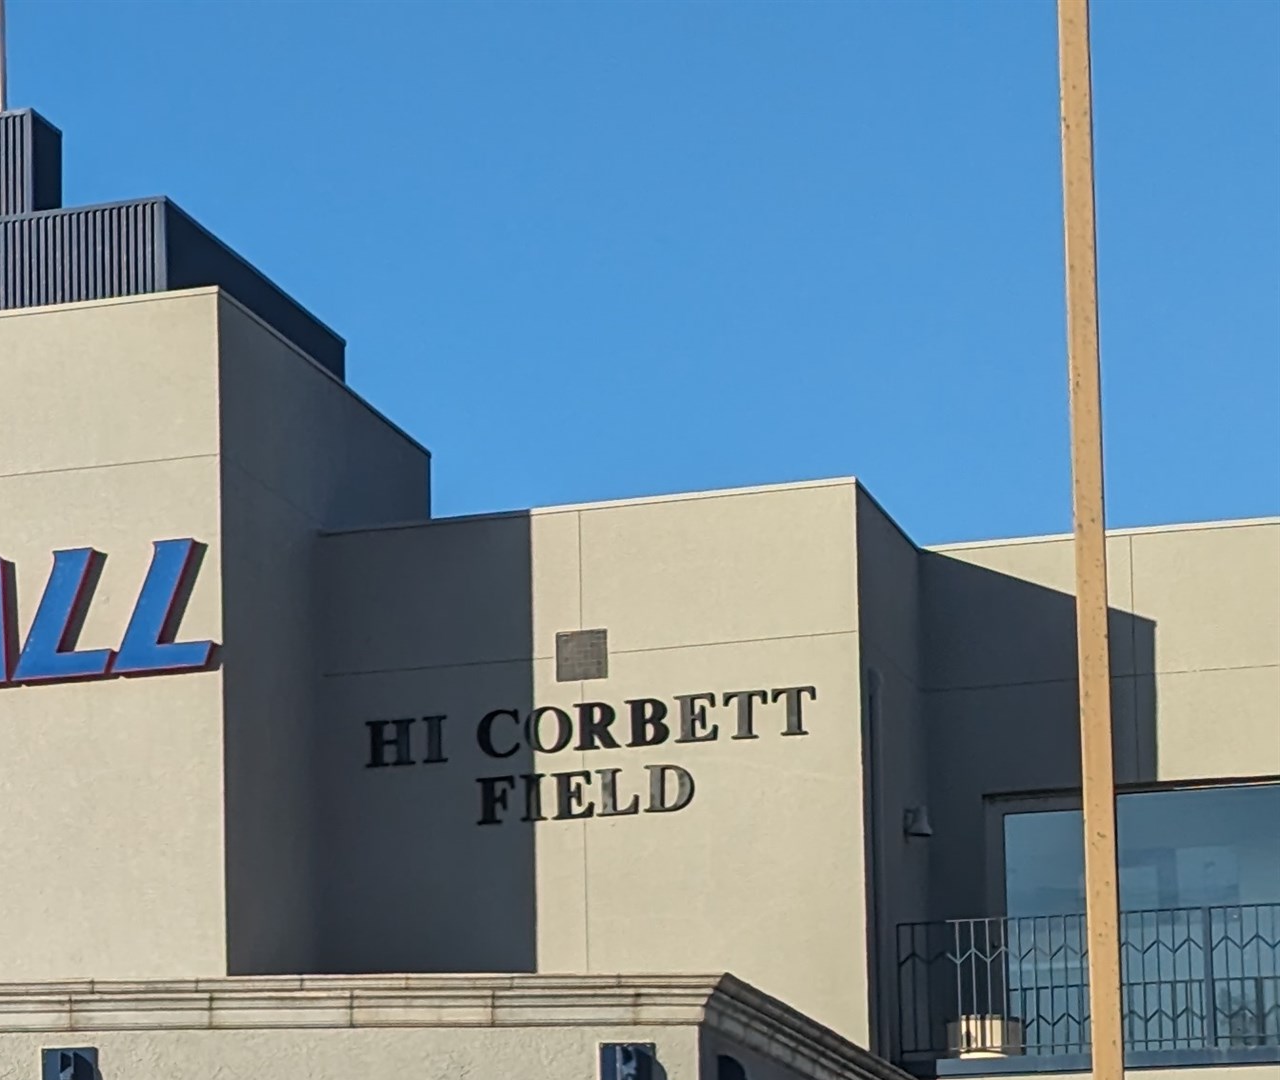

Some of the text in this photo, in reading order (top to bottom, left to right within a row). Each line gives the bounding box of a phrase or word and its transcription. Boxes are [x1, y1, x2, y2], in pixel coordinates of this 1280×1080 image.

[365, 685, 817, 768] HI CORBETT
[476, 763, 696, 825] FIELD
